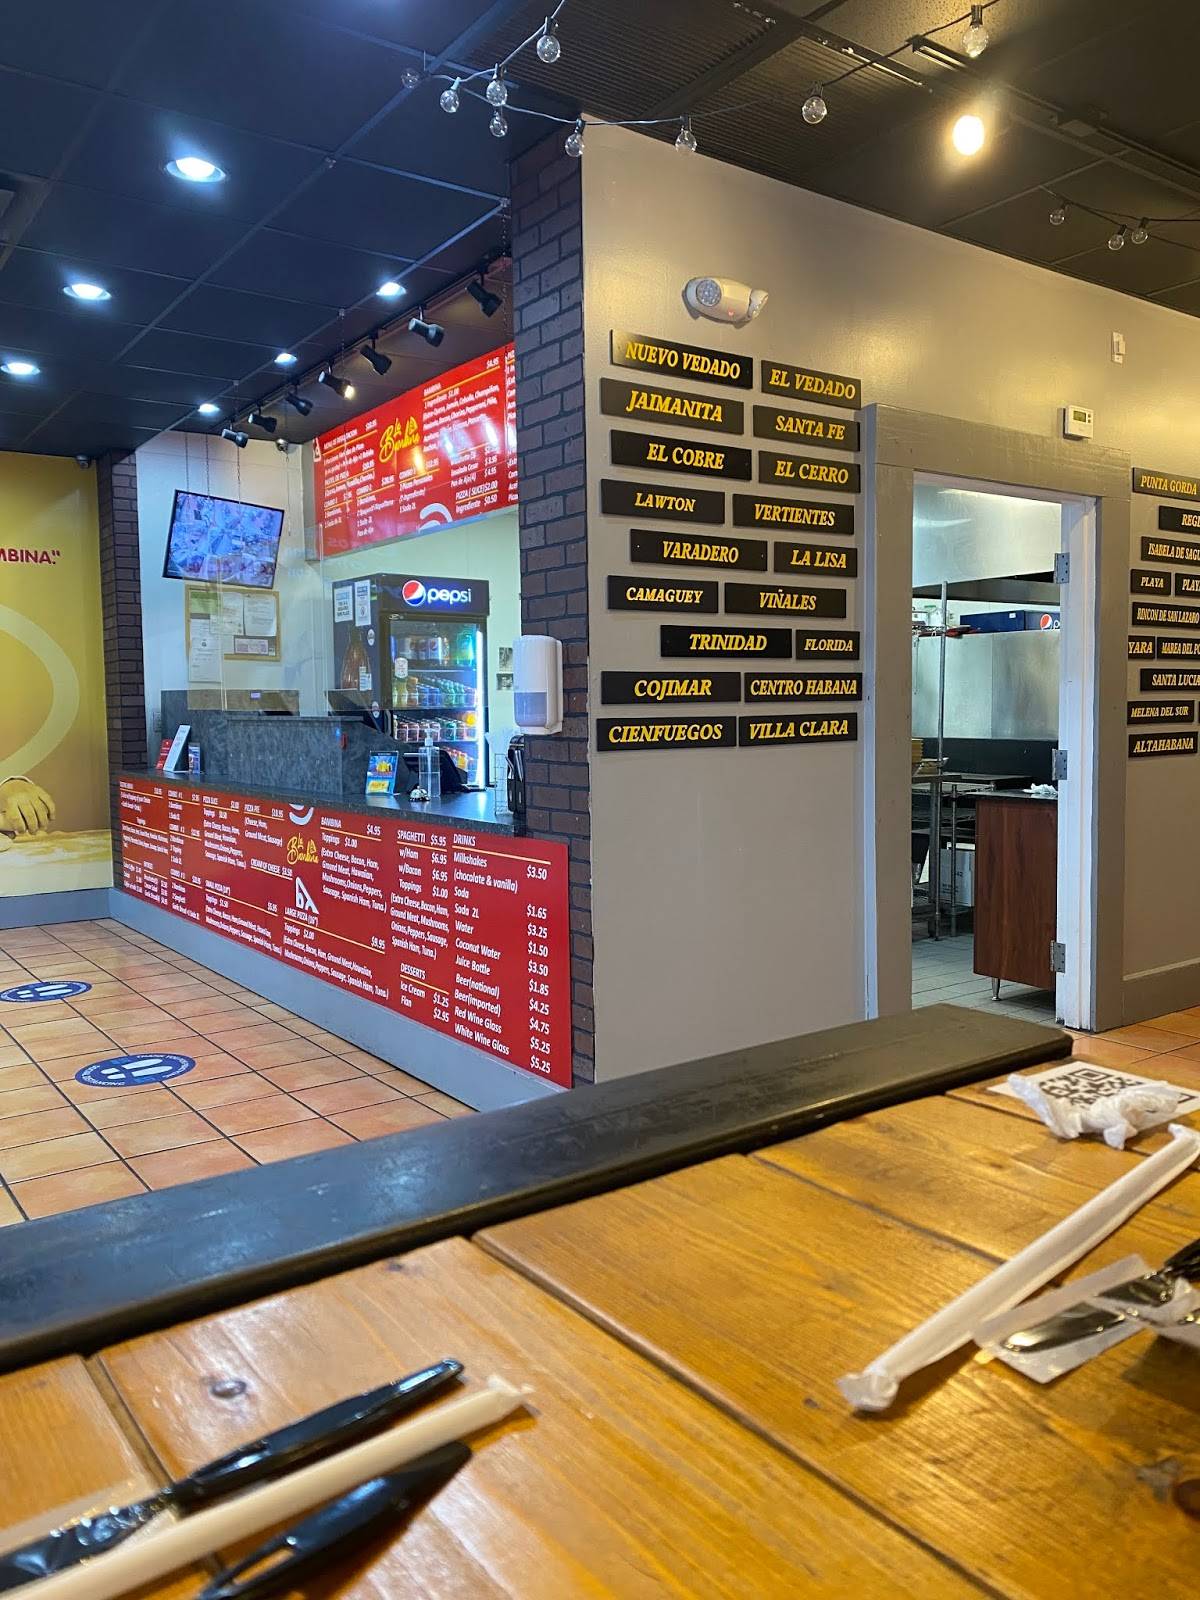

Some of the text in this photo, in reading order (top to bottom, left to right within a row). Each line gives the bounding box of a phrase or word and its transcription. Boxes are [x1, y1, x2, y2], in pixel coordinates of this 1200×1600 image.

[626, 342, 740, 379] NUEVO VEDADO
[769, 368, 855, 399] EL VEDADO
[626, 391, 723, 422] JAIMANITA
[776, 415, 845, 440] SANTA FE
[647, 443, 724, 470] EL COBRE
[775, 460, 849, 484] EL CERRO
[1141, 475, 1197, 495] PUNTA GORDA
[634, 492, 696, 512] LAWTON
[754, 503, 835, 526] VERTIENTES
[662, 540, 739, 563] VARADERO
[790, 550, 847, 568] LA LISA
[1148, 543, 1174, 558] ISABELA
[1176, 547, 1184, 559] DE
[1141, 576, 1164, 588] PLAYA
[427, 588, 472, 604] pepsi
[626, 586, 703, 604] CAMAGUEY
[759, 589, 816, 611] VIÑALES
[1137, 608, 1200, 624] RINCON DE SAN LAZARO
[689, 634, 767, 651] TRINIDAD
[804, 639, 853, 652] FLORIDA
[1128, 641, 1153, 654] YARA
[1162, 642, 1181, 654] MAREA
[1182, 643, 1192, 654] DEL
[750, 680, 857, 696] CENTRO HABANA
[1152, 674, 1177, 686] SANTA
[634, 680, 712, 700] COJIMAR
[1131, 706, 1188, 718] MELENA DEL SUR
[608, 724, 722, 743] CIENFUEGOS
[749, 720, 849, 740] VILLA CLARA
[1133, 738, 1194, 753] ALTAHABANA
[367, 824, 381, 836] $4.95
[397, 829, 447, 847] SPAGHETTI $5.95
[453, 833, 476, 847] DRINKS
[399, 847, 447, 865] w/Ham $6.95
[453, 852, 488, 868] Milkshakes
[398, 863, 448, 882] w/Bacon $6.95
[453, 868, 518, 893] (chocolate & vanilla)
[526, 864, 548, 880] $3.50
[399, 879, 448, 899] Toppings $1.00
[454, 886, 469, 899] Soda
[454, 903, 479, 919] Soda 2L
[526, 904, 548, 920] $1.65
[455, 920, 548, 939] Water $3.25
[455, 938, 501, 960] Coconut Water
[528, 942, 549, 957] $1.50
[400, 962, 426, 980] DESSERTS
[455, 955, 490, 975] Juice Bottle
[528, 959, 549, 976] $3.50
[400, 981, 426, 998] Ice Cream
[528, 979, 549, 996] $1.85
[401, 995, 412, 1007] Flan
[433, 992, 449, 1008] $1.25
[529, 998, 549, 1015] $4.25
[433, 1008, 449, 1023] $2.95
[454, 1006, 502, 1034] Red Wine Glass
[529, 1016, 550, 1035] $4.75
[454, 1023, 510, 1055] White Wine Glass
[530, 1036, 550, 1054] $5.25
[530, 1055, 550, 1074] $5.25
